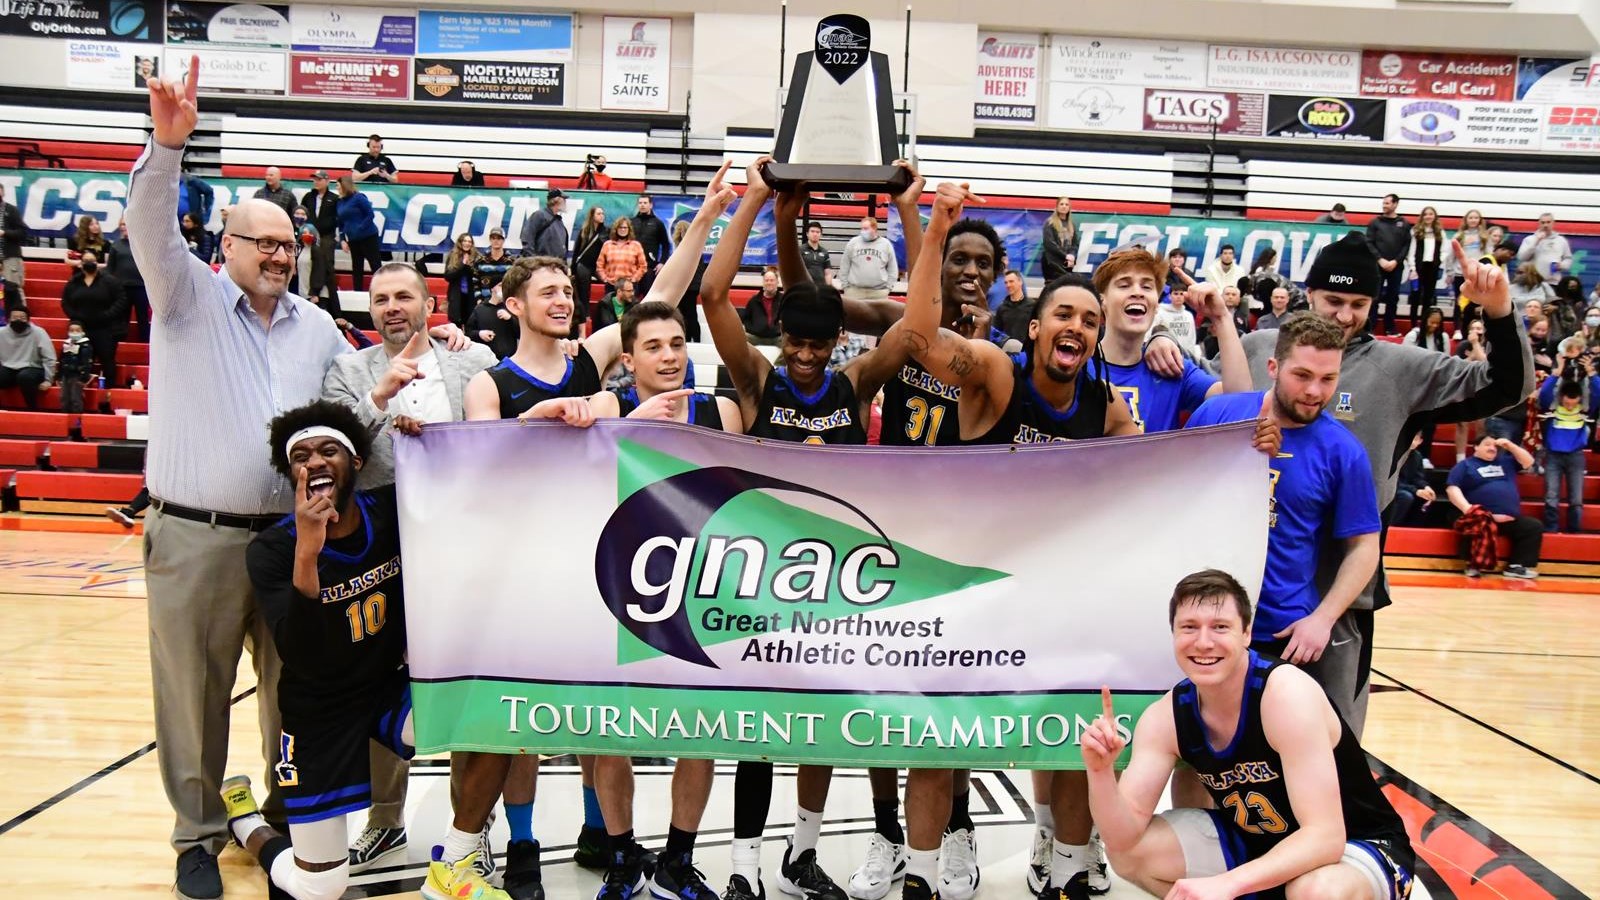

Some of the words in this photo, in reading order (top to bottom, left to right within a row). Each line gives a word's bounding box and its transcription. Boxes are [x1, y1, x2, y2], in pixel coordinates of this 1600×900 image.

[10, 2, 36, 19] Life
[38, 4, 52, 16] In
[55, 5, 99, 19] Motion
[31, 22, 106, 35] OlyOrtho.com
[307, 28, 356, 38] OLYMPIA
[70, 43, 120, 52] CAPITAL
[616, 45, 657, 58] SAINTS
[991, 44, 1036, 59] SAINTS
[210, 59, 244, 71] Golob
[824, 52, 859, 65] 2022
[1247, 50, 1323, 64] ISAACSON
[1328, 53, 1354, 66] CO.
[300, 61, 400, 77] McKINNEY'S
[463, 64, 560, 78] NORTHWEST
[977, 64, 1035, 78] ADVERTISE
[1217, 65, 1269, 76] INDUSTRIAL
[1272, 68, 1300, 77] TOOLS
[1418, 61, 1443, 74] Car
[1445, 62, 1513, 76] Accident?
[463, 75, 560, 86] HARLEY-DAVIDSON
[624, 73, 649, 84] THE
[462, 91, 533, 100] NWHARLEY.COM
[463, 84, 500, 92] LOCATED
[612, 85, 659, 97] SAINTS
[984, 80, 1027, 97] HERE!
[1361, 84, 1388, 93] Harold
[1431, 81, 1456, 94] Call
[1459, 83, 1496, 96] Carr!
[976, 105, 1033, 118] 360.438.4305
[1154, 97, 1223, 118] TAGS
[1308, 111, 1346, 126] ROXY
[1548, 106, 1600, 126] BR
[0, 176, 129, 233] CS
[1329, 274, 1353, 285] NOPO
[770, 406, 852, 432] ALASKA
[905, 396, 946, 447] 31
[320, 555, 400, 603] ALASKA
[626, 535, 900, 623] gnac
[346, 591, 387, 643] 10
[701, 606, 782, 633] Great
[790, 611, 944, 638] Northwest
[741, 638, 856, 665] Athletic
[864, 643, 1027, 667] Conference
[500, 695, 826, 745] TOURNAMENT
[1198, 761, 1279, 790] LASKA
[1222, 791, 1289, 834] 23
